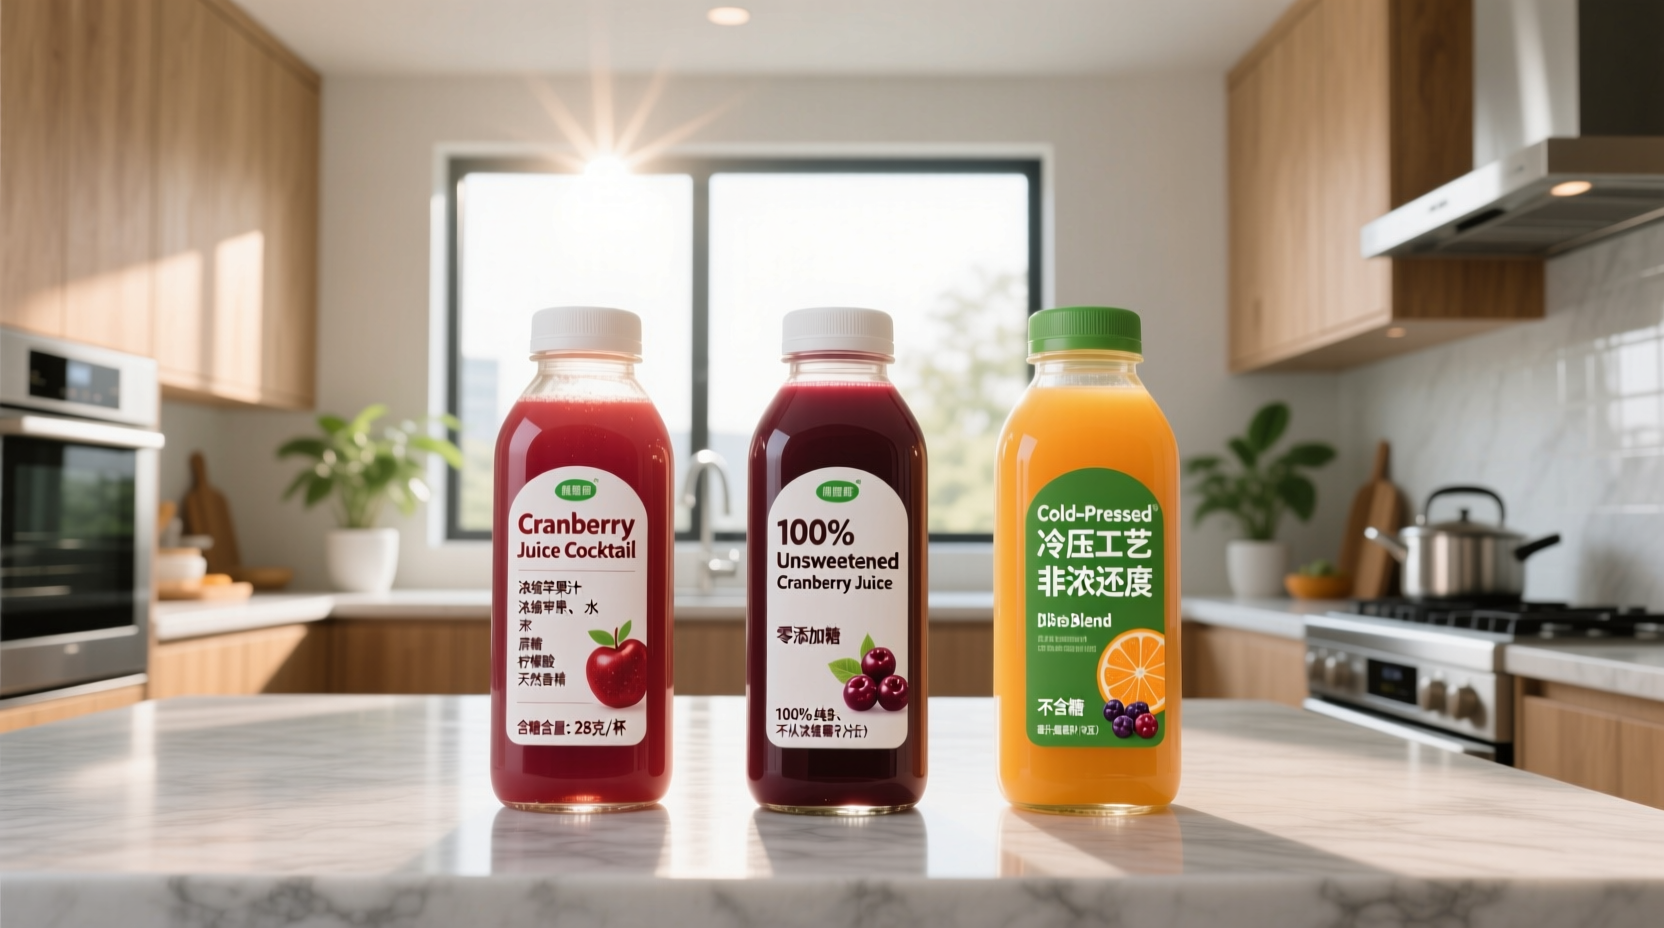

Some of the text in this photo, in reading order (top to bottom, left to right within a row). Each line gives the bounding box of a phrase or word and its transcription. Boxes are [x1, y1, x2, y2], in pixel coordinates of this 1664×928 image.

[1037, 504, 1152, 522] Cold-Pressed
[518, 512, 635, 540] Cranberry
[777, 519, 854, 546] 100%
[517, 540, 636, 558] Juice Cocktail
[1037, 528, 1152, 559] 冷压工艺
[777, 552, 899, 569] Unsweetened
[777, 575, 893, 594] Cranberry Juice
[1037, 565, 1152, 597] 非浓还度
[777, 626, 840, 645] 零添加糖
[776, 708, 812, 721] 100%
[1037, 698, 1084, 716] 不含糖
